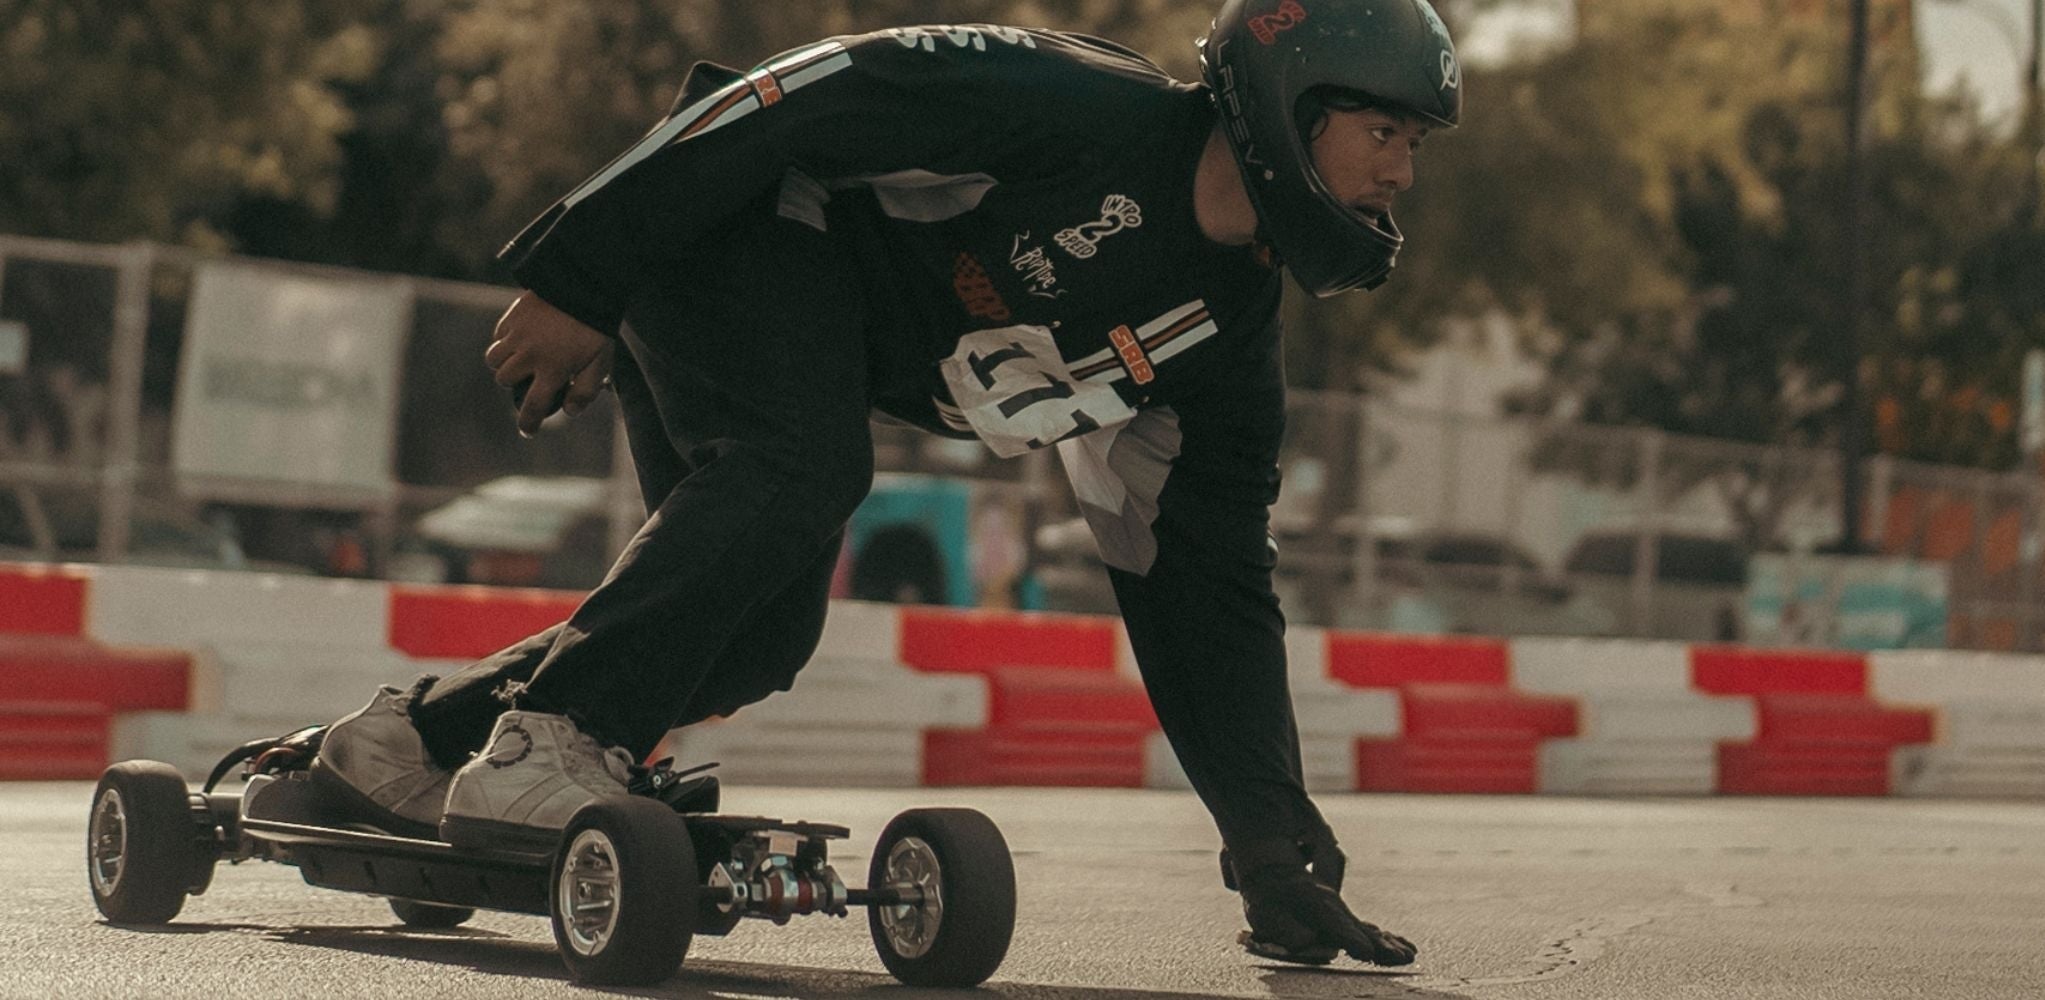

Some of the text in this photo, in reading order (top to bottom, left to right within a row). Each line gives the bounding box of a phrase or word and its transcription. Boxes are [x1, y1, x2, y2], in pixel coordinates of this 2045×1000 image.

[1101, 194, 1142, 228] INTRO
[1053, 228, 1098, 259] SPEED
[1075, 212, 1126, 246] 2
[1108, 324, 1155, 385] SRB
